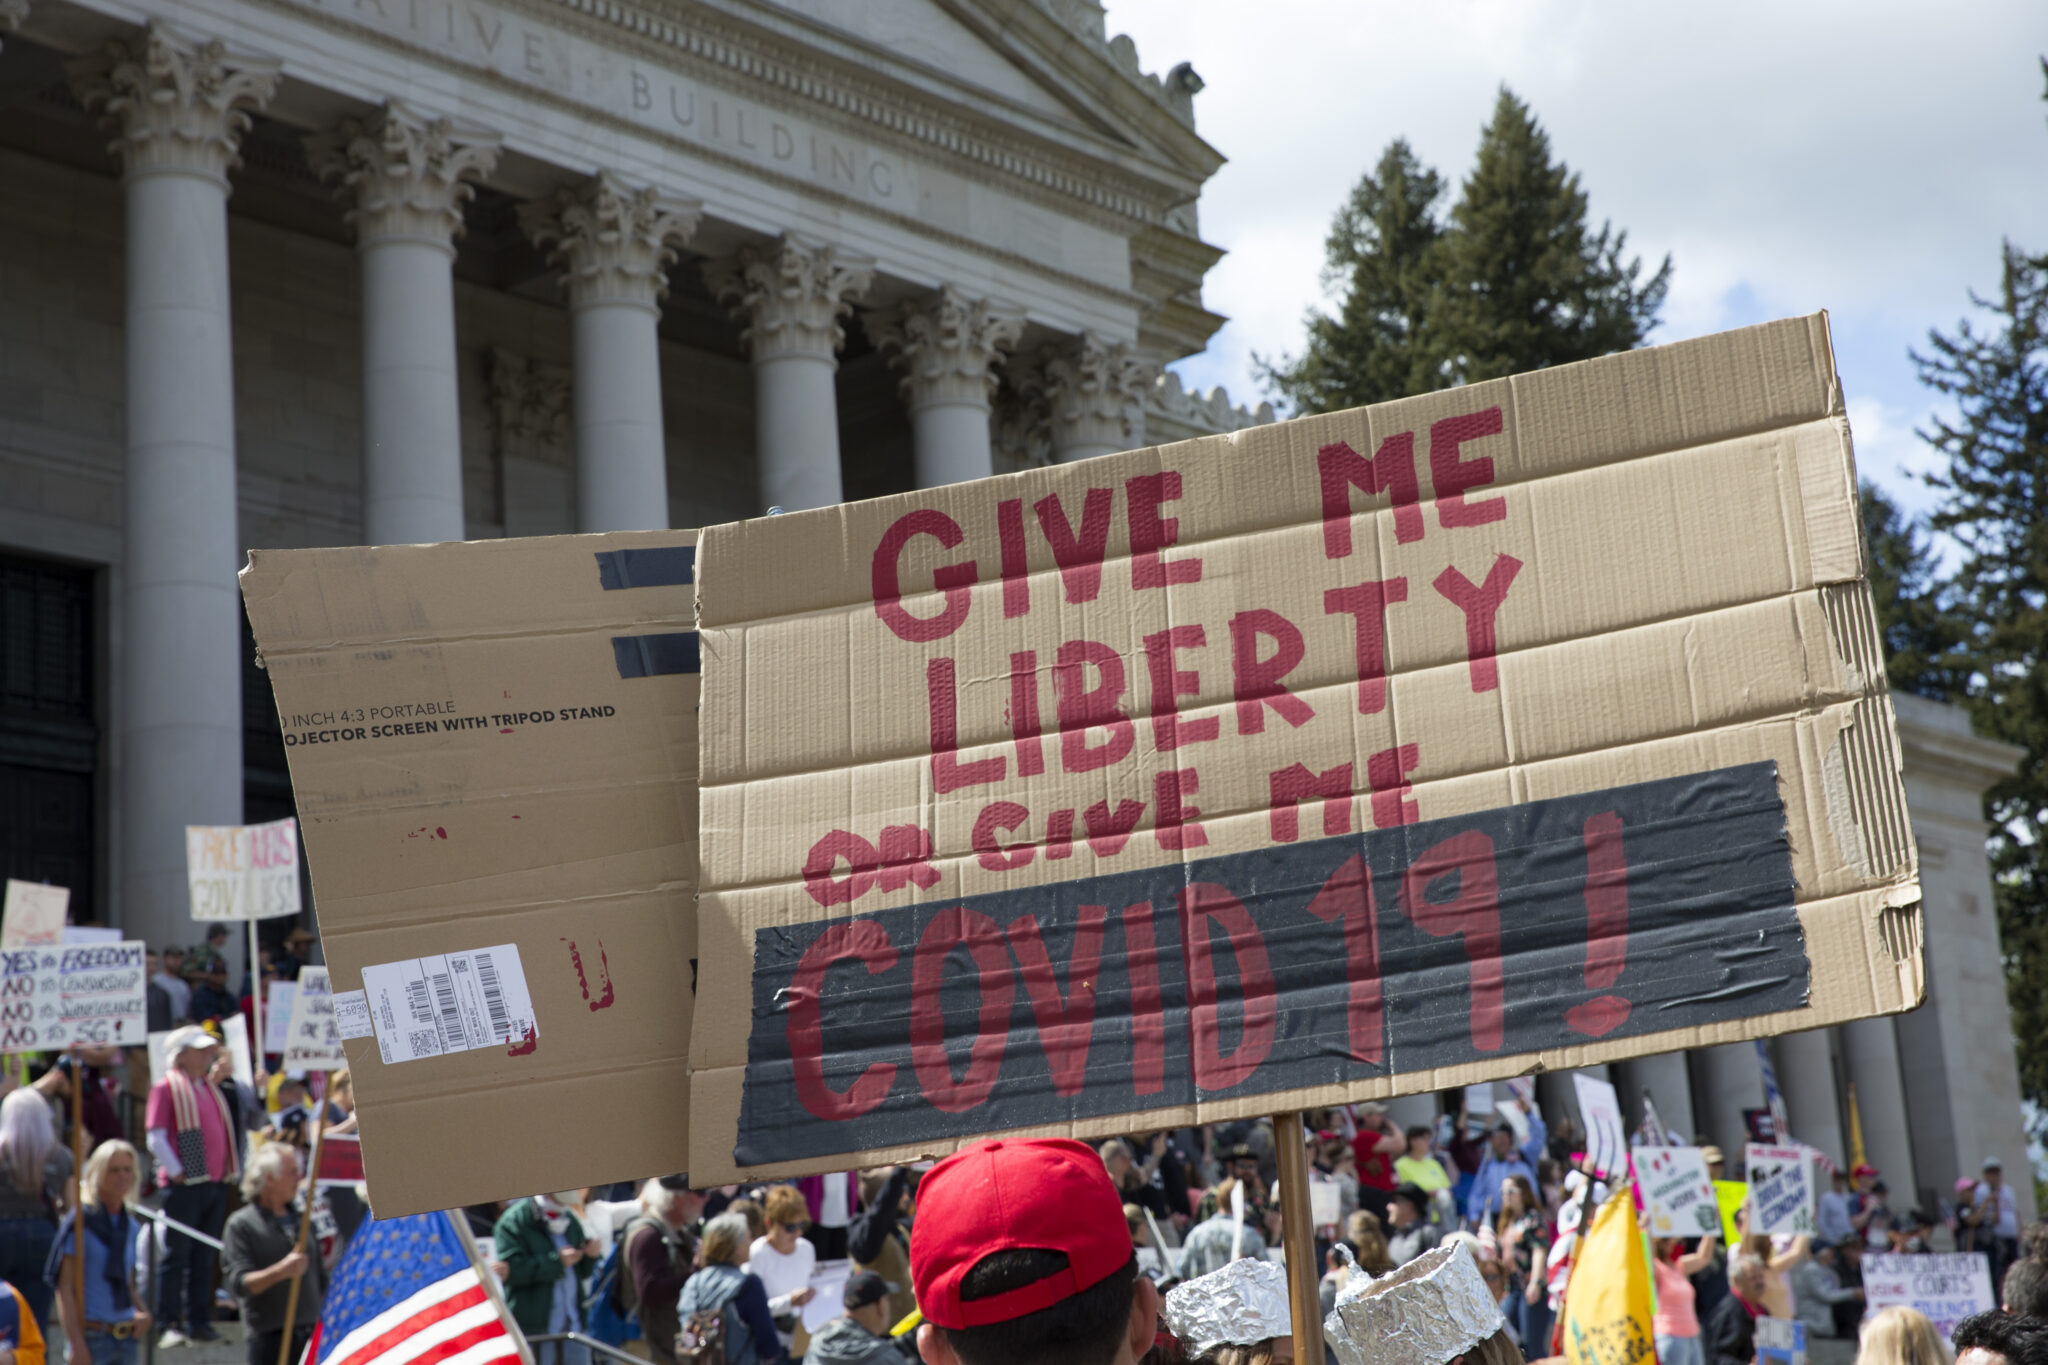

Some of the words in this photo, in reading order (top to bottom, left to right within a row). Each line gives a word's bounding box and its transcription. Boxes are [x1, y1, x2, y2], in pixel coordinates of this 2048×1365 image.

[630, 70, 894, 198] BUILDING
[872, 471, 1202, 642] GIVE
[1318, 406, 1506, 559] ME
[926, 554, 1523, 794] LIBERTY
[284, 727, 367, 747] OJECTOR
[371, 720, 438, 739] SCREEN
[442, 715, 488, 731] WITH
[491, 710, 555, 727] TRIPOD
[559, 705, 616, 721] STAND
[292, 711, 336, 728] INCH
[340, 709, 365, 723] 4:3
[370, 700, 456, 720] PORTABLE
[802, 822, 941, 907] OR
[972, 768, 1208, 871] GIVE
[1269, 743, 1419, 843] ME
[2, 951, 37, 975] YES
[60, 946, 142, 971] FREEDOM
[2, 975, 34, 997] NO
[787, 883, 1277, 1121] COVID
[2, 1001, 33, 1023] NO
[2, 1026, 37, 1049] NO
